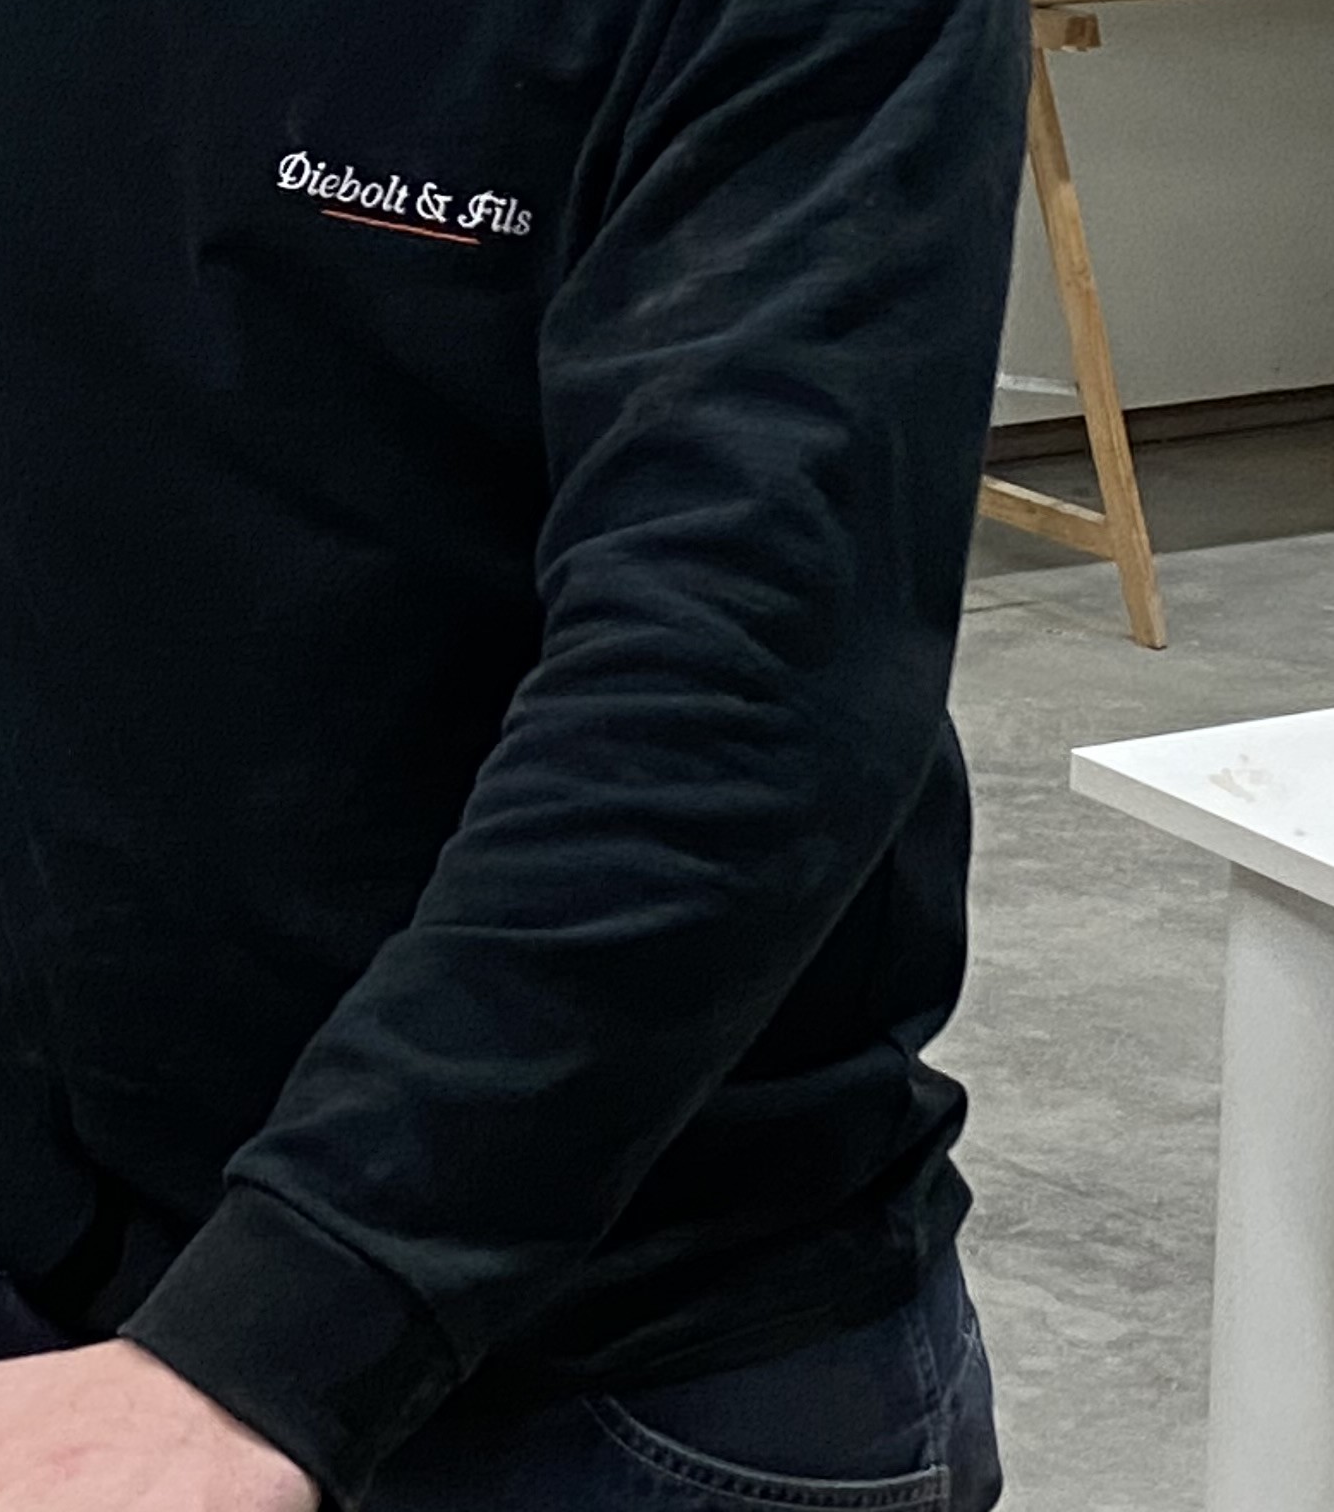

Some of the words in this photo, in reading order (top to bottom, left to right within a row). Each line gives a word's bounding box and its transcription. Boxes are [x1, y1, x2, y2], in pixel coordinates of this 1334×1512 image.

[276, 150, 410, 214] Diebolt
[415, 181, 454, 223] &
[456, 190, 533, 235] Fils
